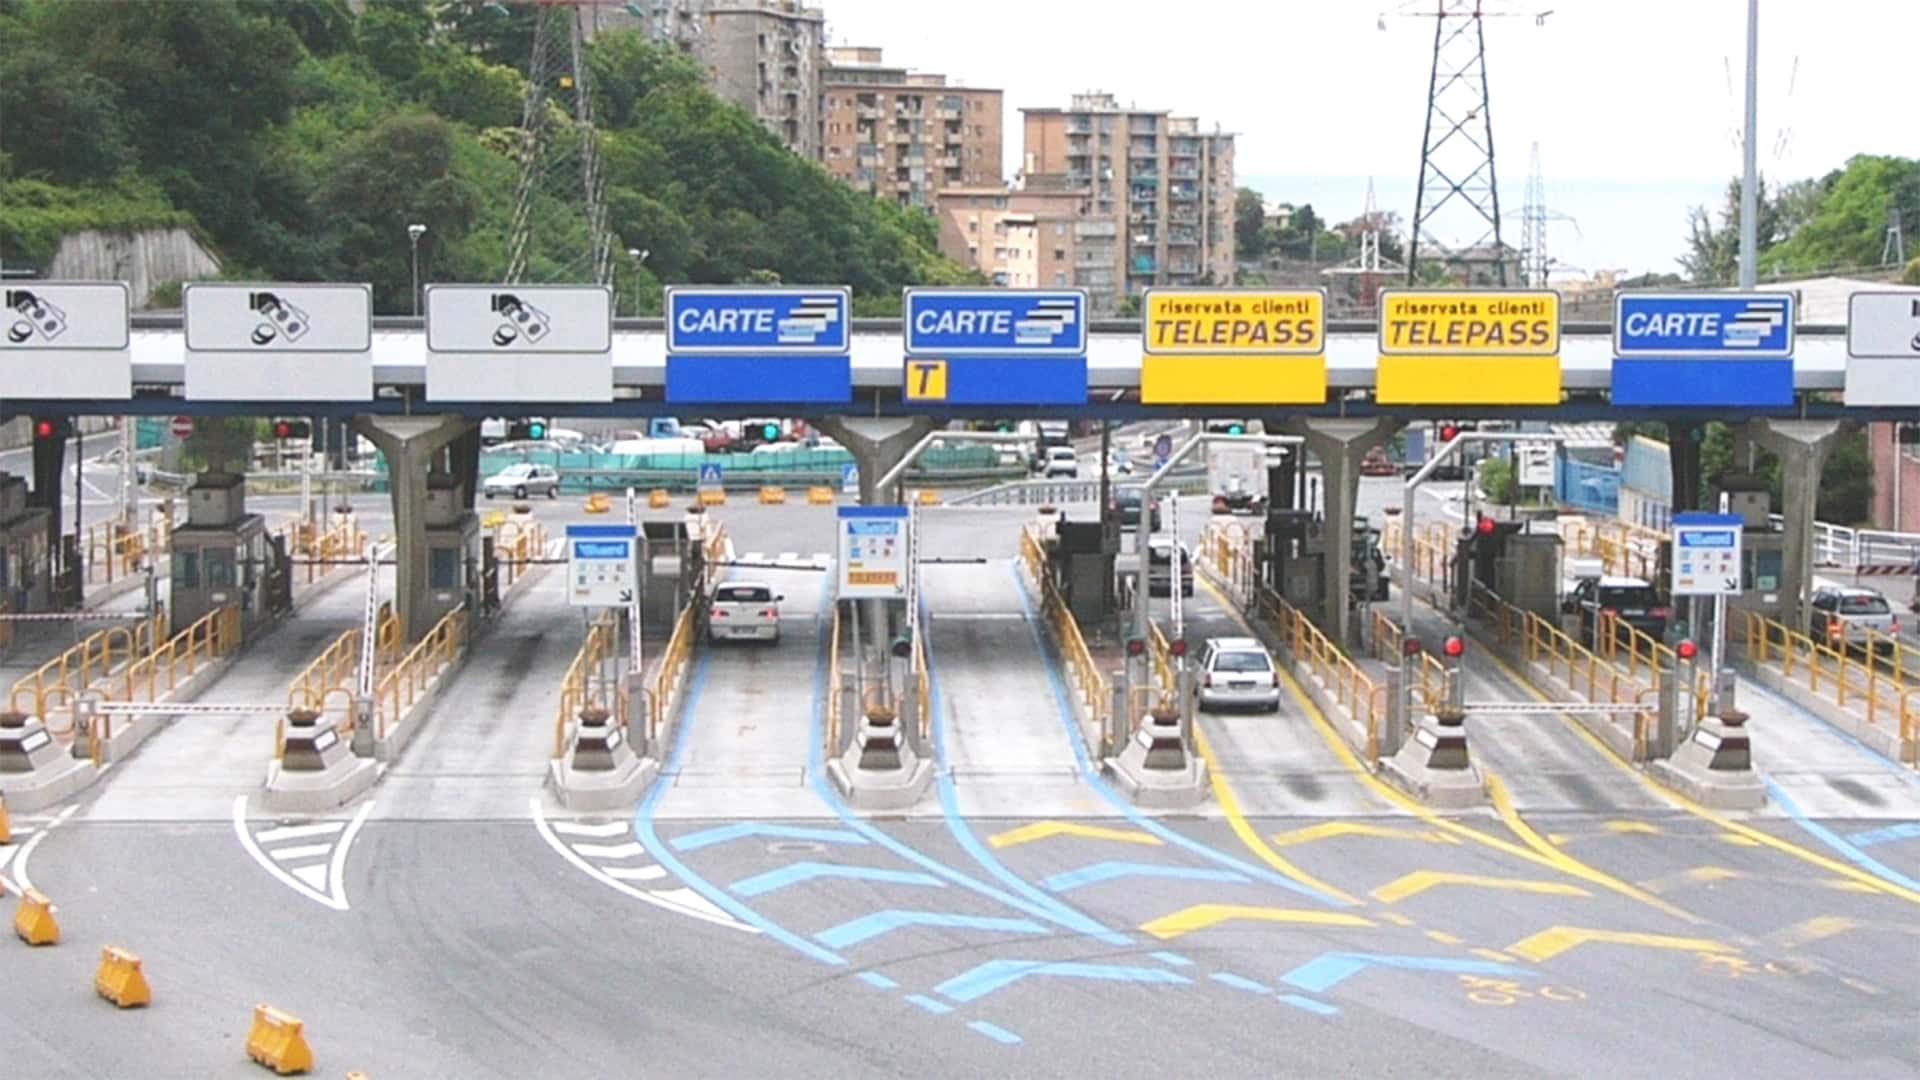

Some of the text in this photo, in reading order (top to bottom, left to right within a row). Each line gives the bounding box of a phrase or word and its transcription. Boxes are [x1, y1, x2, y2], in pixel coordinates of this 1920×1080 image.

[1159, 299, 1310, 315] riservata clienti
[1395, 300, 1546, 316] riservata clienti
[677, 308, 775, 333] CARTE
[915, 310, 1012, 335] CARTE
[1154, 319, 1316, 345] TELEPASS
[1390, 320, 1550, 346] TELEPASS
[1624, 312, 1721, 337] CARTE
[914, 363, 939, 395] T
